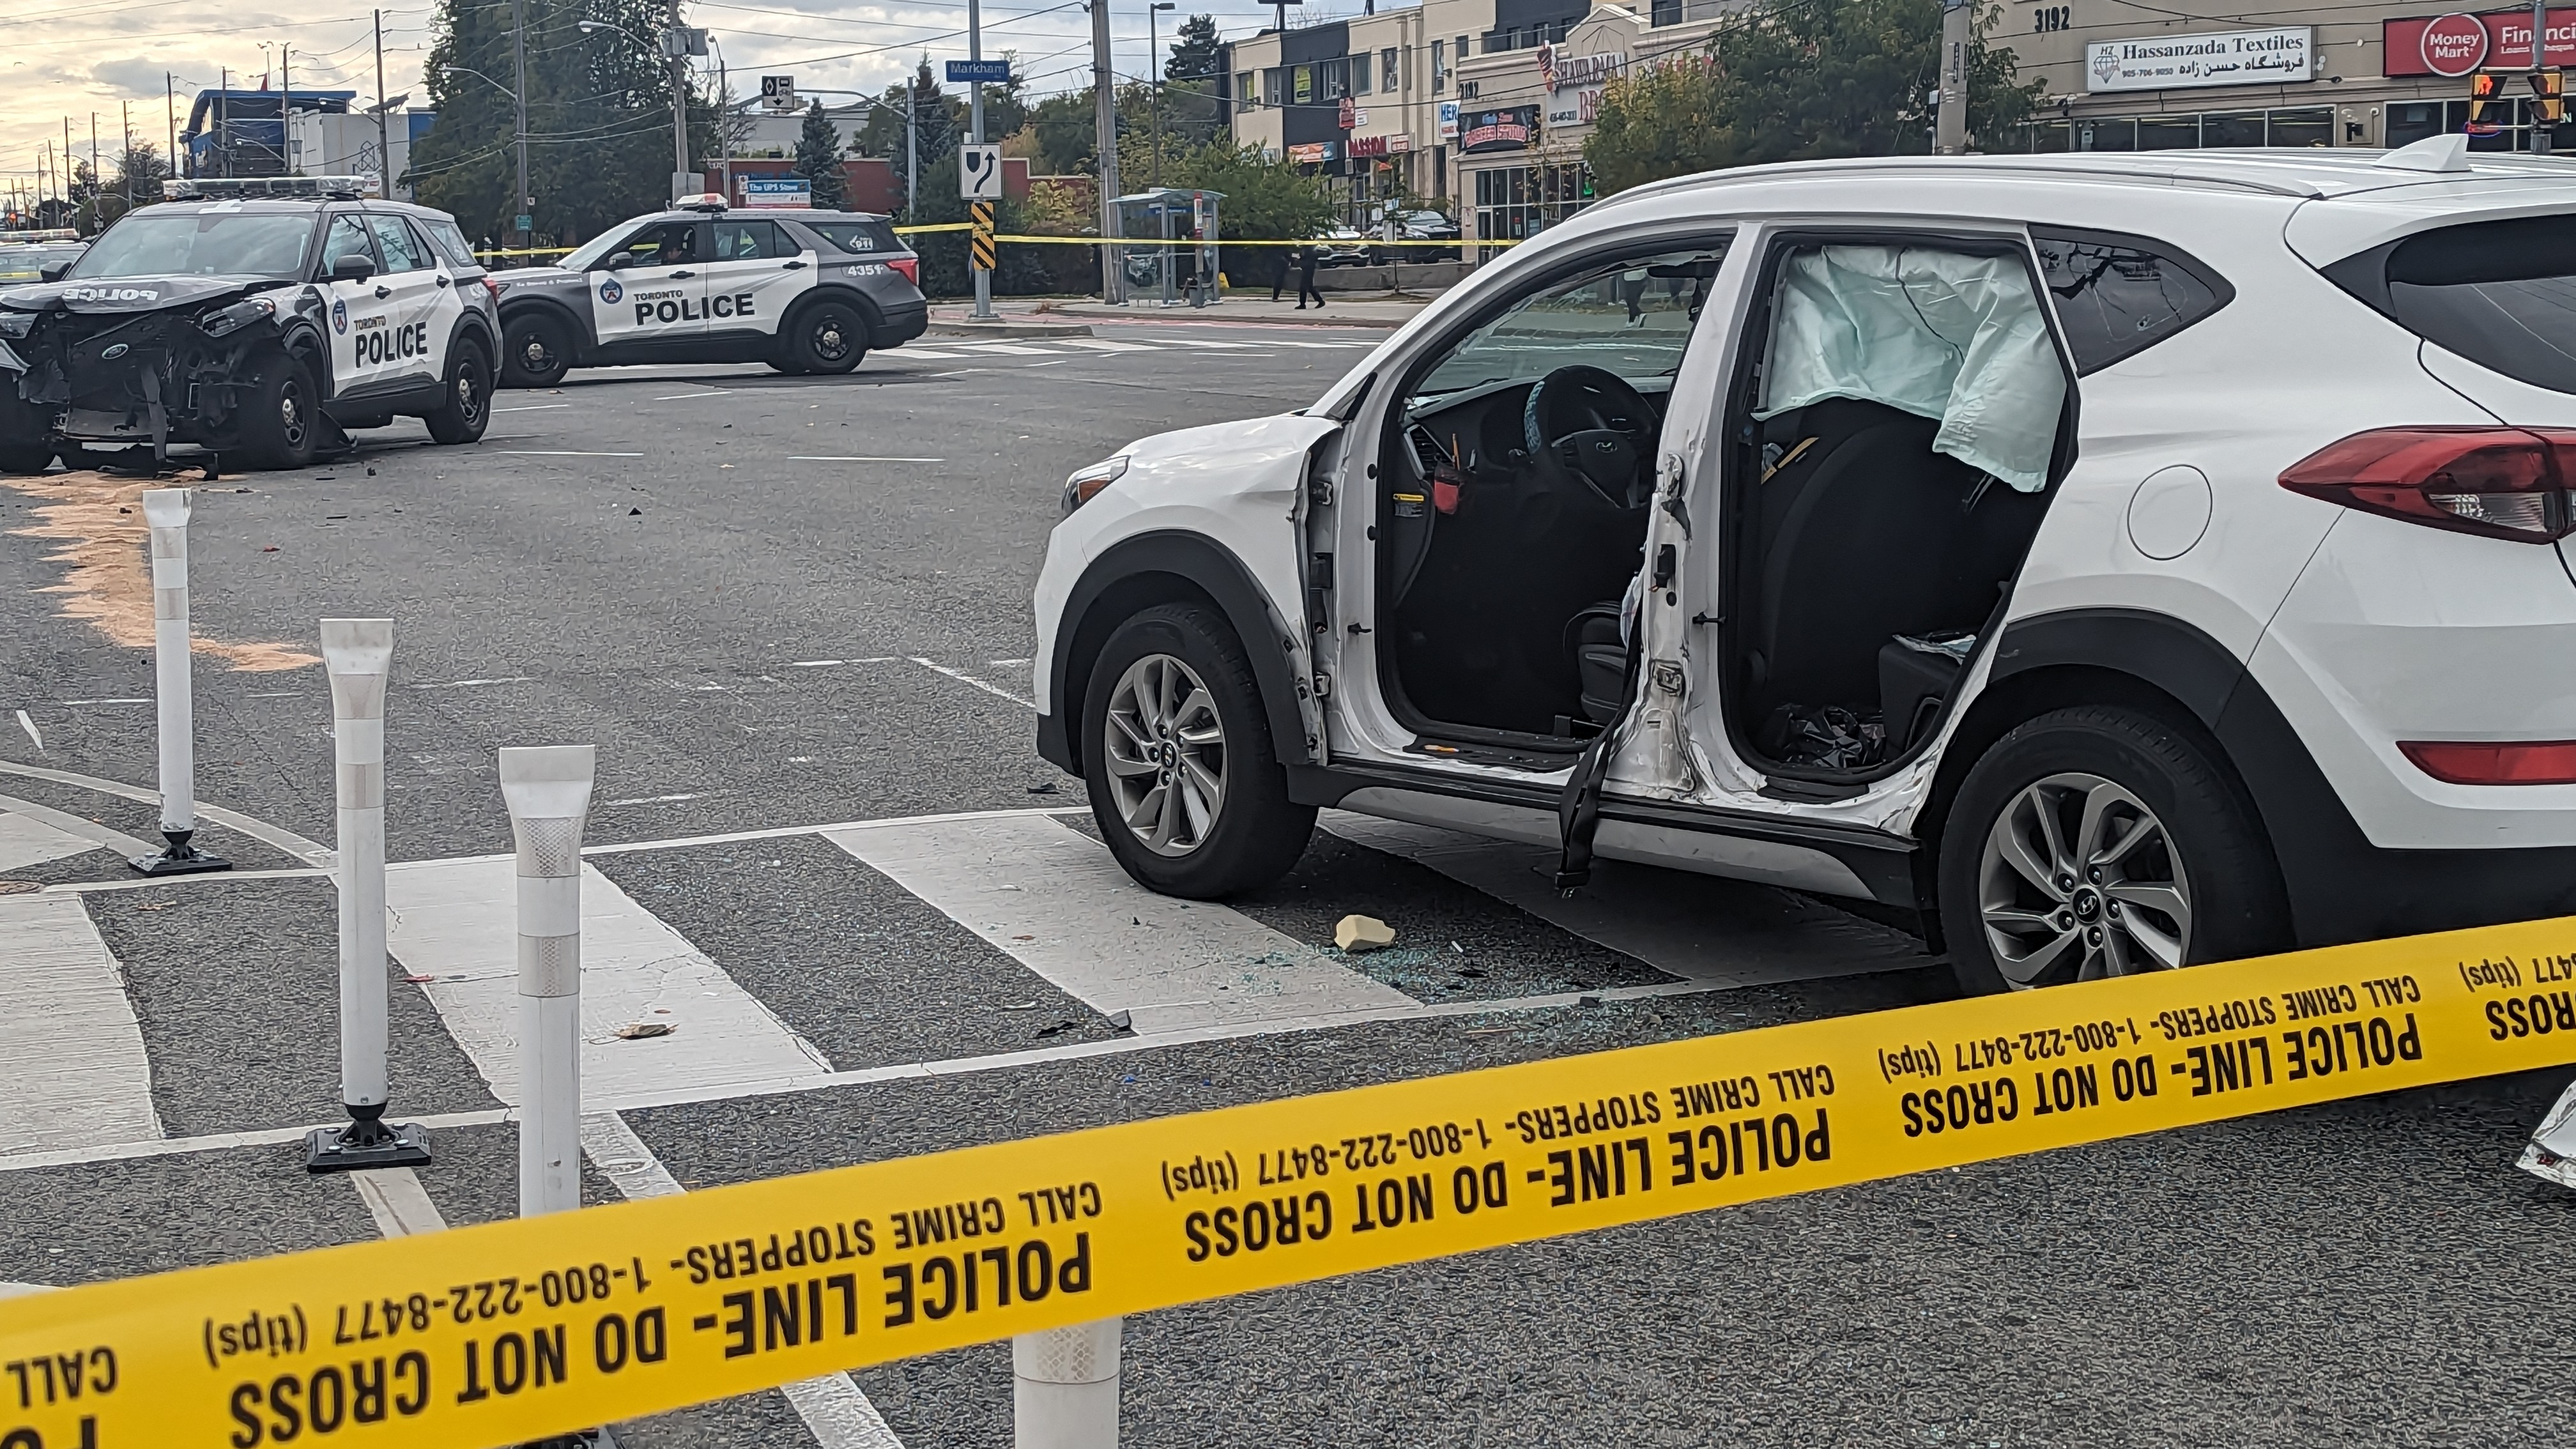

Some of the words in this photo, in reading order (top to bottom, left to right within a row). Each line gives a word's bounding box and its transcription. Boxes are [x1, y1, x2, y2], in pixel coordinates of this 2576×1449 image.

[2034, 6, 2070, 33] 3192
[2430, 34, 2480, 47] Money
[2502, 22, 2576, 44] Finnci
[951, 63, 1005, 74] Markham
[2100, 45, 2114, 56] HZ
[2122, 39, 2226, 60] Hassanzada
[2232, 35, 2303, 53] Textiles
[2435, 46, 2470, 58] Mart
[633, 289, 684, 302] TORONTO
[635, 293, 755, 326] POLICE
[355, 321, 427, 368] POLICE
[2361, 975, 2421, 1008] CALL
[2459, 956, 2522, 992] (tips)
[2281, 985, 2357, 1020] CRIME
[2485, 991, 2576, 1041] ROSS
[1879, 1040, 1940, 1084] (tips)
[2283, 1013, 2423, 1081] POLICE
[1670, 1076, 1760, 1119] CRIME
[1768, 1064, 1835, 1102] CALL
[2034, 1064, 2099, 1116] NOT
[2112, 1054, 2158, 1101] DO
[1901, 1077, 2018, 1137] CROSS
[1668, 1108, 1830, 1186] POLICE
[1162, 1151, 1238, 1201] (tips)
[1453, 1162, 1508, 1215] DO
[891, 1197, 1005, 1250] CRIME
[1018, 1182, 1102, 1227] CALL
[1186, 1191, 1331, 1262] CROSS
[1352, 1174, 1434, 1233] NOT
[883, 1232, 1091, 1329] POLICE
[204, 1303, 308, 1369] (tips)
[594, 1306, 666, 1374] DO
[6, 1346, 118, 1409] CALL
[457, 1324, 566, 1404] NOT
[231, 1351, 429, 1449] CROSS
